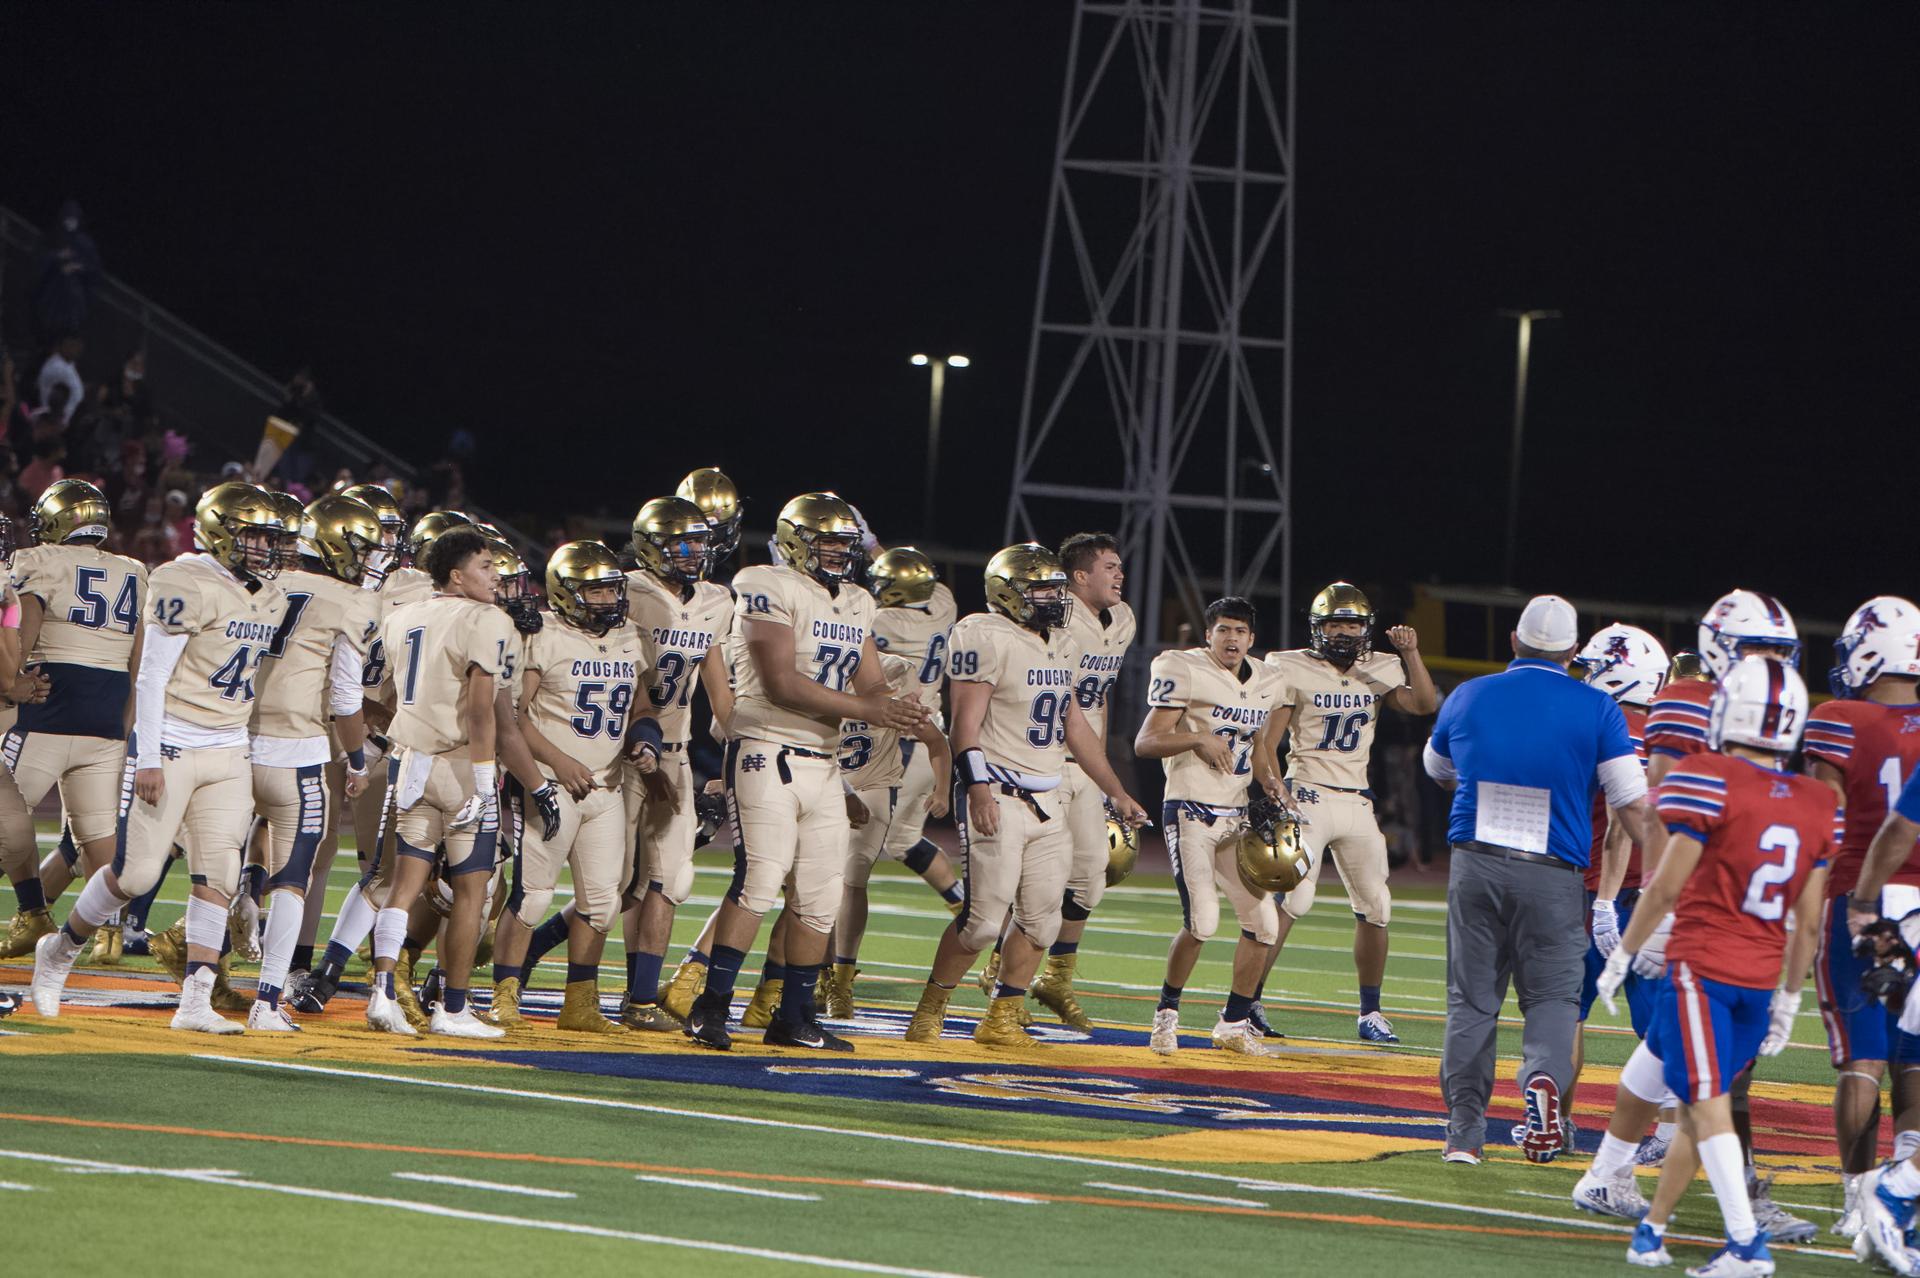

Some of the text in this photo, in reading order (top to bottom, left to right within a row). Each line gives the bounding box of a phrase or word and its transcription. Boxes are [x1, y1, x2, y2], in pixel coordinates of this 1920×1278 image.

[67, 565, 139, 635] 54
[652, 627, 713, 650] COUGARS
[812, 620, 864, 645] COUGARS
[402, 626, 427, 705] 1
[571, 660, 635, 679] COUGARS
[951, 651, 978, 676] 99
[1151, 678, 1175, 703] 22
[1314, 693, 1381, 709] COUGARS
[570, 681, 633, 740] 59
[1211, 704, 1269, 726] COUGARS
[1315, 710, 1370, 753] 16
[1742, 823, 1801, 921] 2
